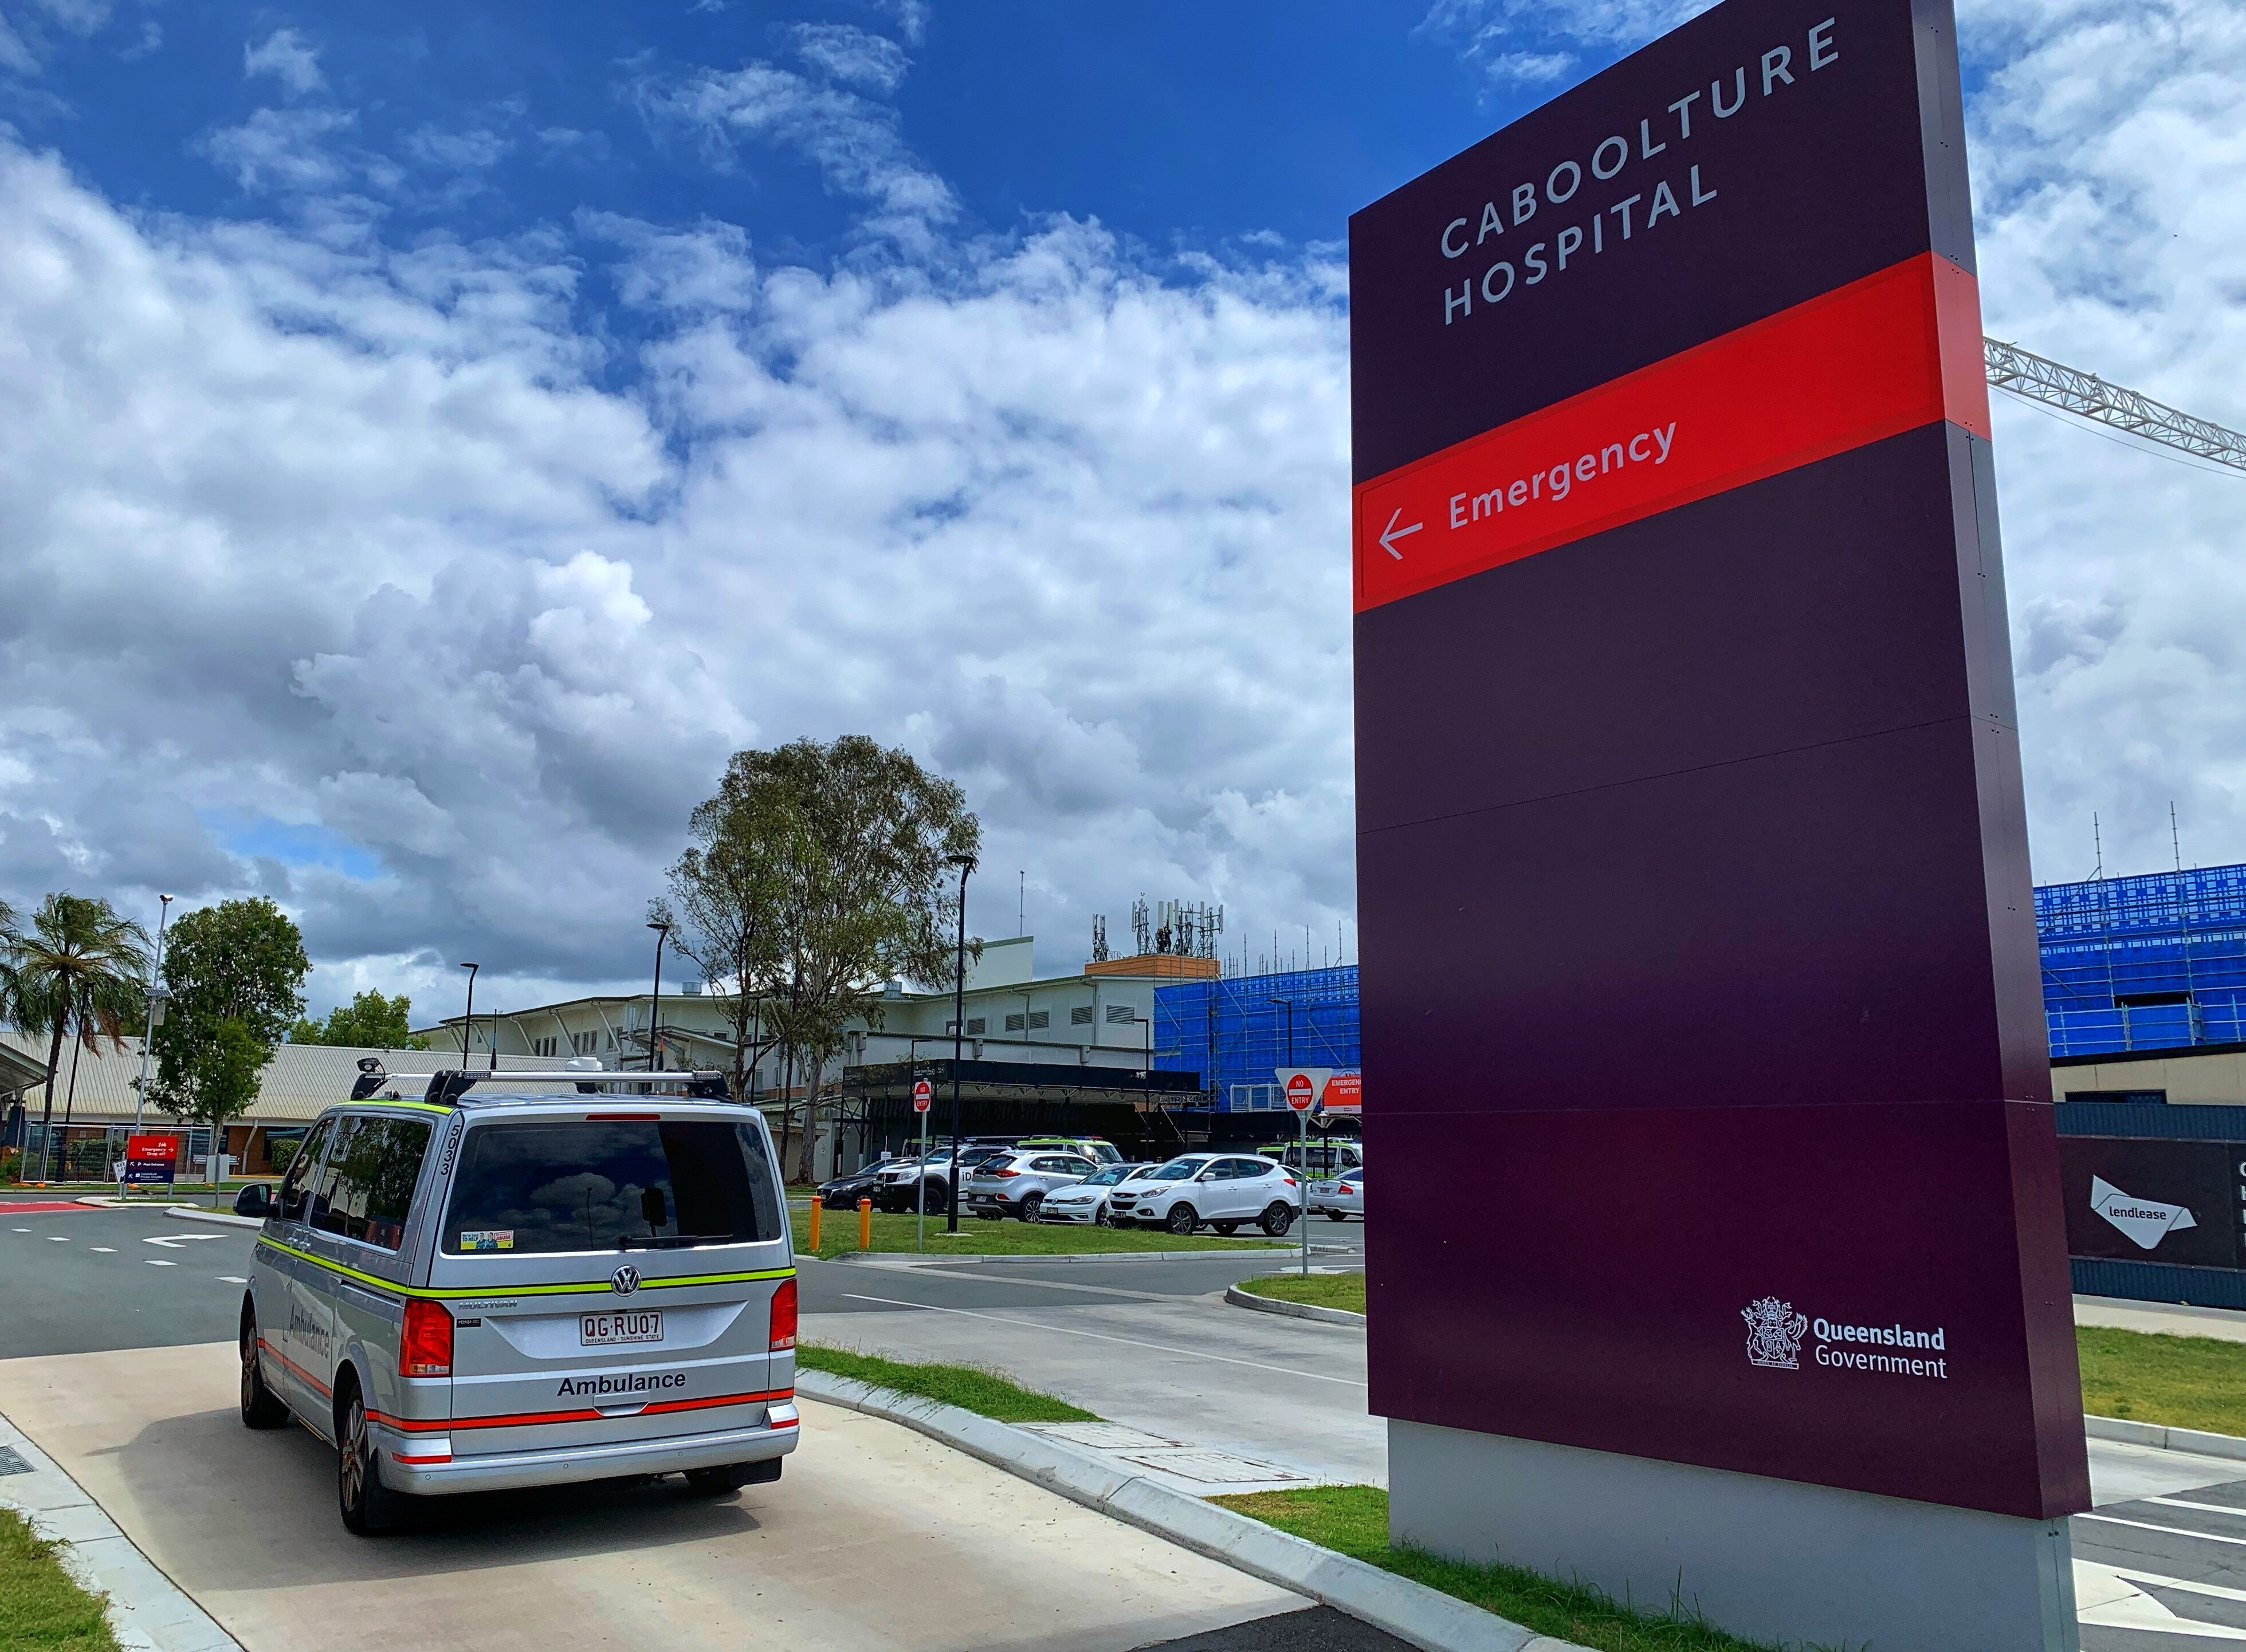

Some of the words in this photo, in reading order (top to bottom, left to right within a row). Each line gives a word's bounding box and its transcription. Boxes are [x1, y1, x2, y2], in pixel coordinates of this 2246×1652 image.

[1440, 17, 1839, 259] CABOOLTURE
[1444, 164, 1718, 325] HOSPITAL
[1449, 421, 1677, 530] Emergency
[1291, 1096, 1309, 1104] ENTRY
[440, 1124, 461, 1175] 5033
[2109, 1206, 2167, 1220] lendlease
[458, 1300, 517, 1310] MULTIVAN
[288, 1303, 330, 1359] Ambulance
[1813, 1318, 1946, 1351] Queensland
[1815, 1344, 1948, 1379] Government
[556, 1373, 686, 1397] Ambulance
